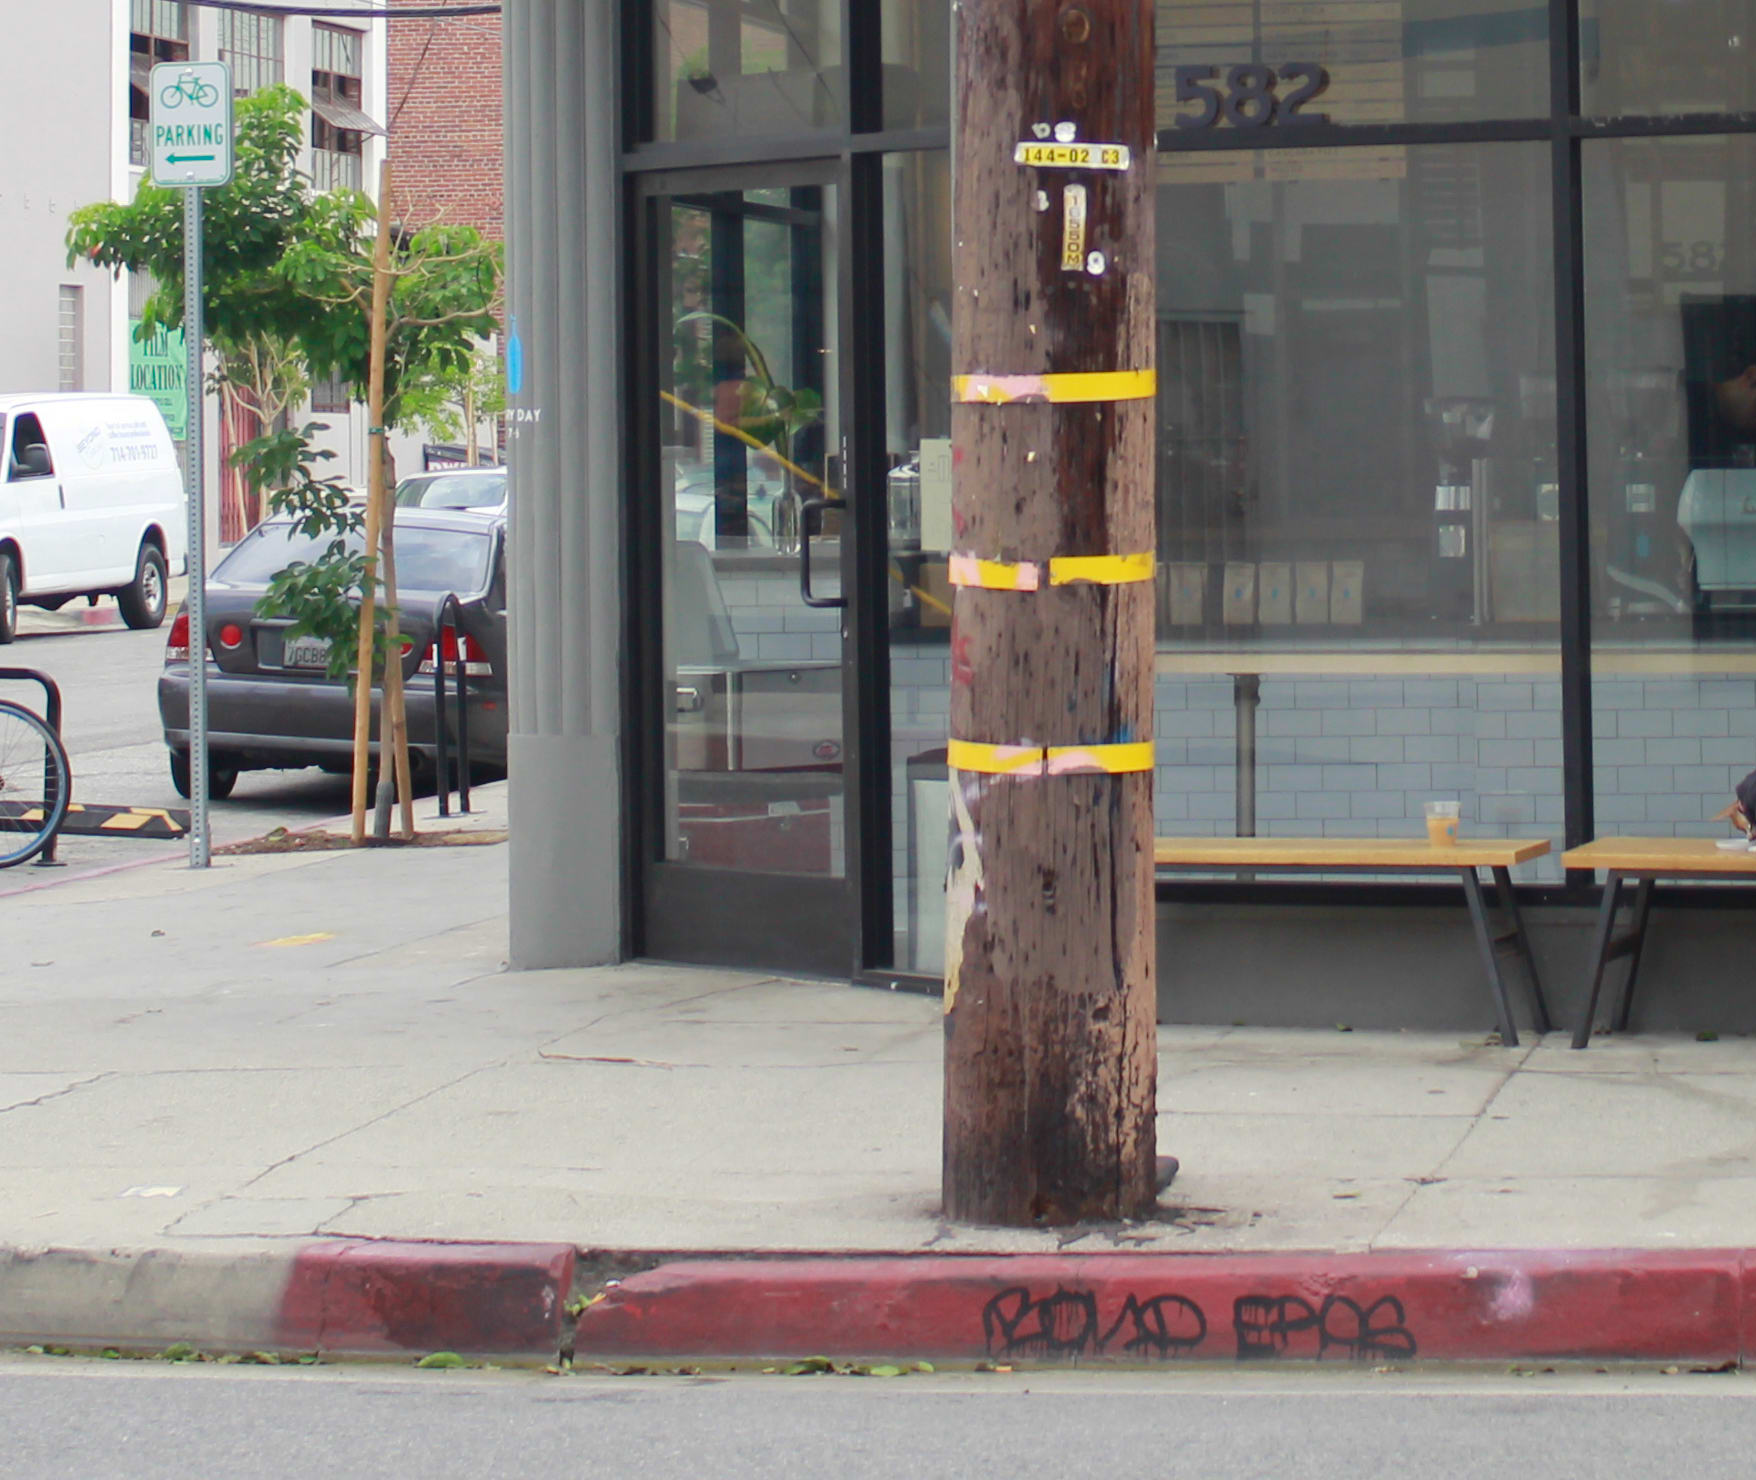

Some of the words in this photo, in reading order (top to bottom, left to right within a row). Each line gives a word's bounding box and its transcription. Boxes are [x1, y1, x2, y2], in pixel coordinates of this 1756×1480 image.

[1173, 61, 1331, 127] 582
[155, 122, 225, 148] PARKING
[1024, 147, 1090, 164] 144-02
[1101, 148, 1120, 165] C3
[130, 363, 184, 392] LOCATION
